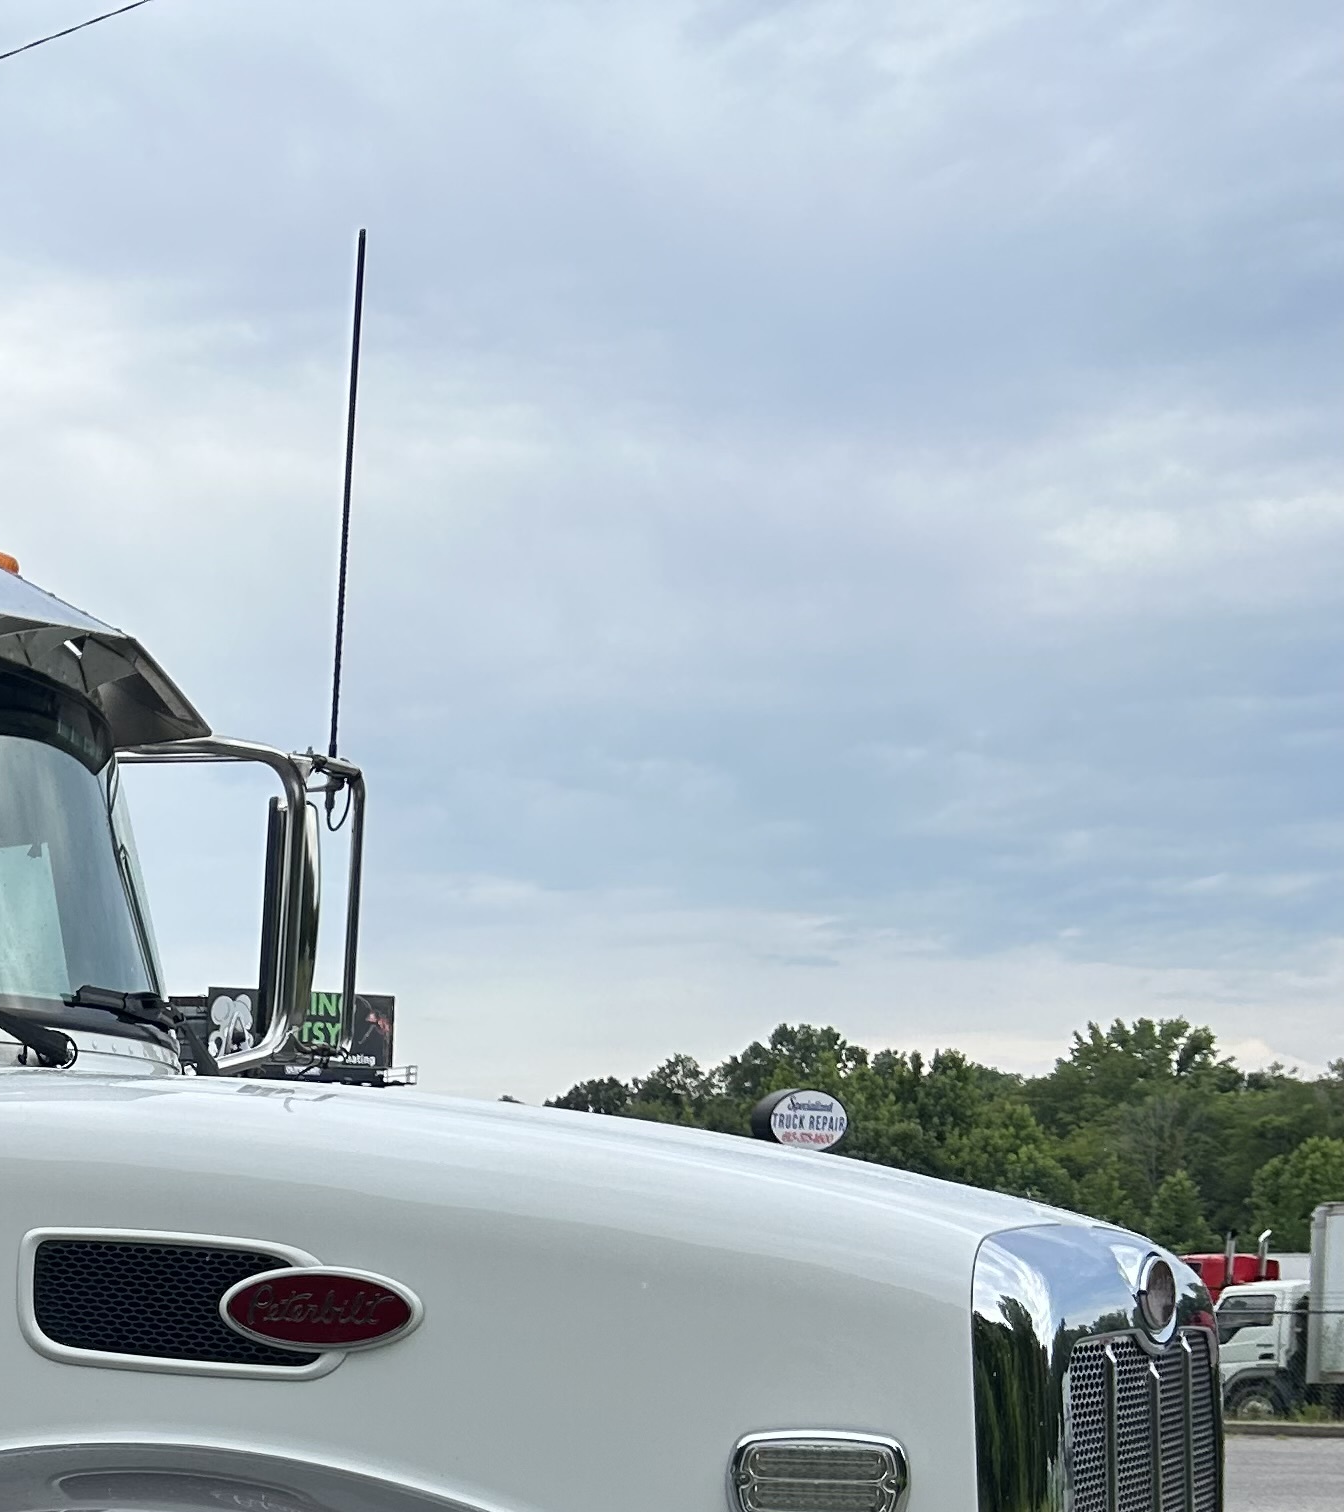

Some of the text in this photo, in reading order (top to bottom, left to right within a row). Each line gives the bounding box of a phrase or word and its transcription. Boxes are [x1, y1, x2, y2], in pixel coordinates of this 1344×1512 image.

[772, 1112, 845, 1132] TRUCK REPAIR
[246, 1284, 395, 1326] Peterbilt
